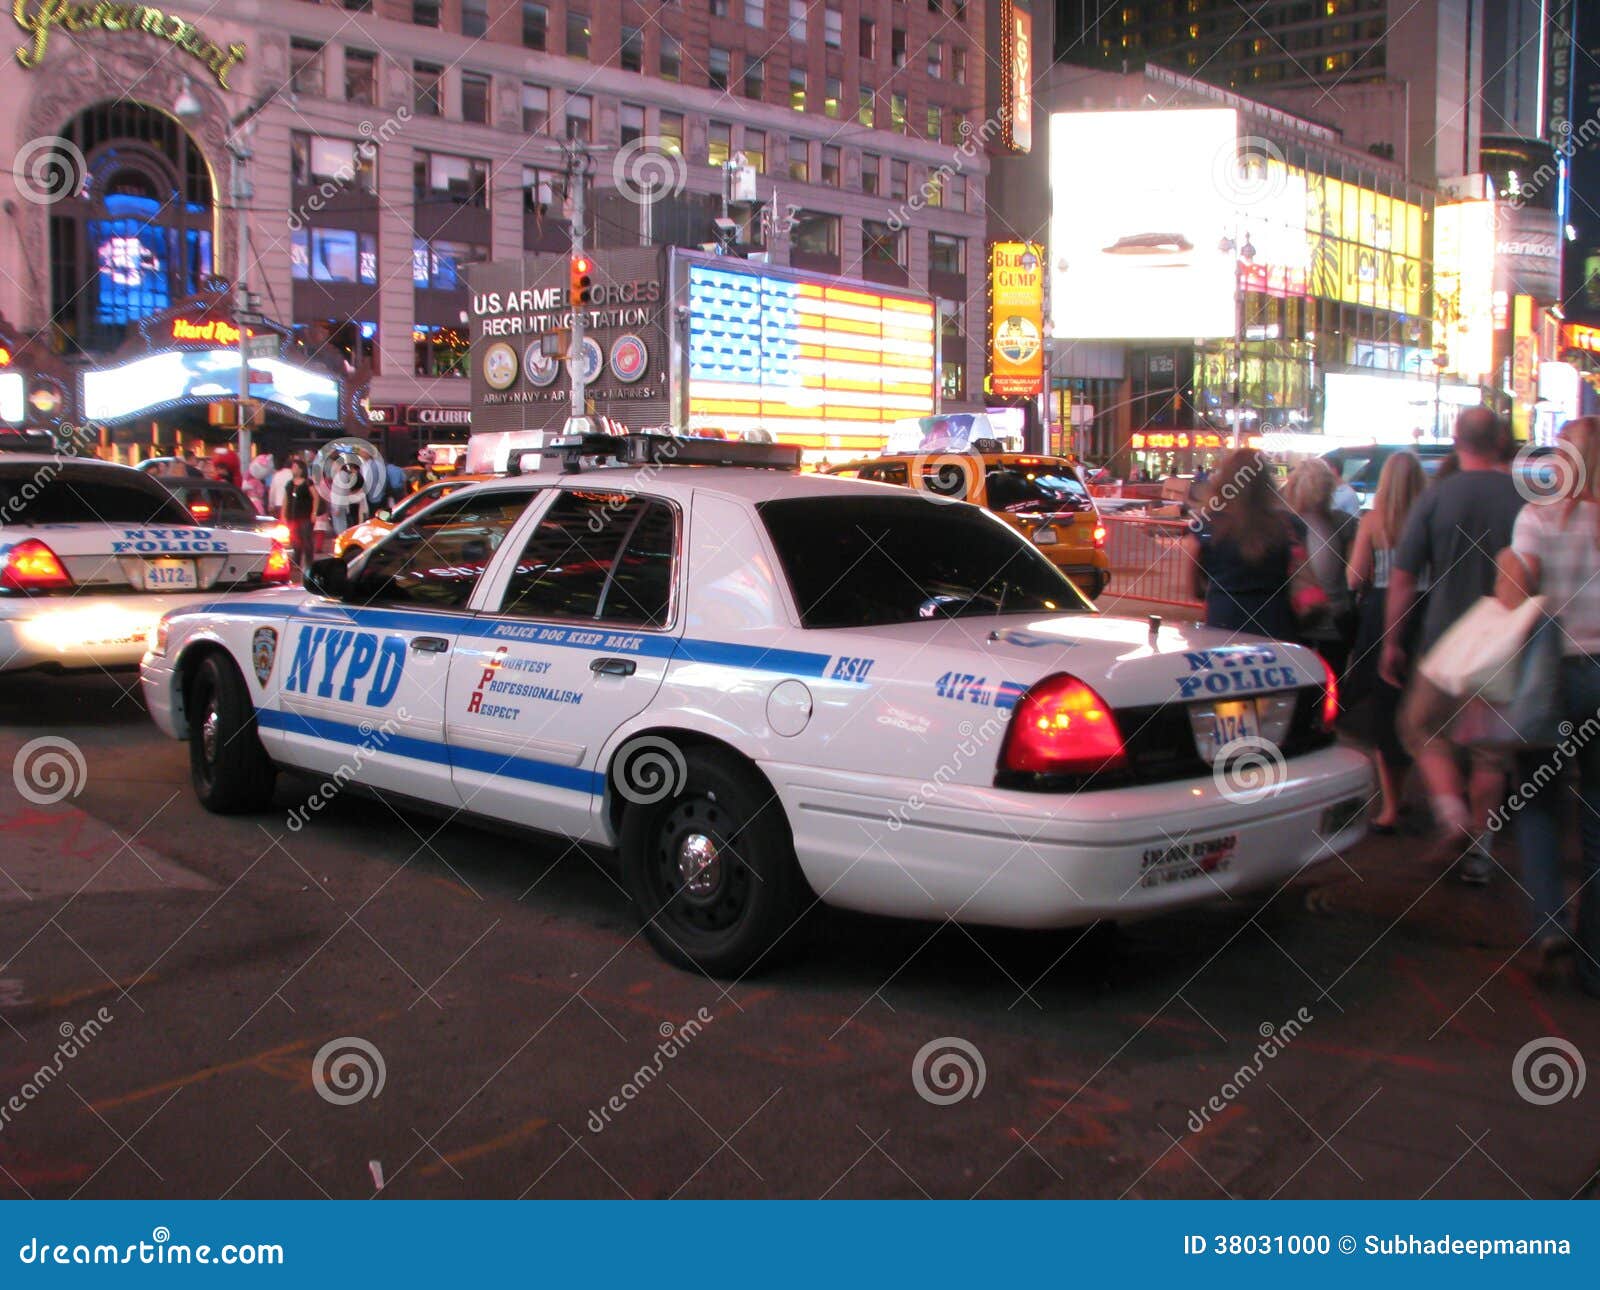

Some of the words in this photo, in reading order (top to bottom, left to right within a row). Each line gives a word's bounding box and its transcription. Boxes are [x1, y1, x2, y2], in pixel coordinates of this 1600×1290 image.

[999, 270, 1036, 286] GUMP
[590, 281, 660, 305] ORCES
[513, 391, 540, 402] NAVY
[112, 541, 229, 553] POLICE
[123, 530, 212, 540] NYPD
[148, 567, 185, 583] 4172
[494, 625, 537, 639] POLICE
[538, 629, 565, 642] DOG
[567, 632, 603, 645] KEEP
[604, 636, 645, 650] BACK
[286, 625, 406, 708] NYPD
[831, 656, 875, 683] ESU
[478, 669, 583, 705] PROFESSIONALISM
[936, 671, 986, 704] 4174
[1176, 666, 1298, 698] POLICE
[467, 691, 521, 720] RESPECT
